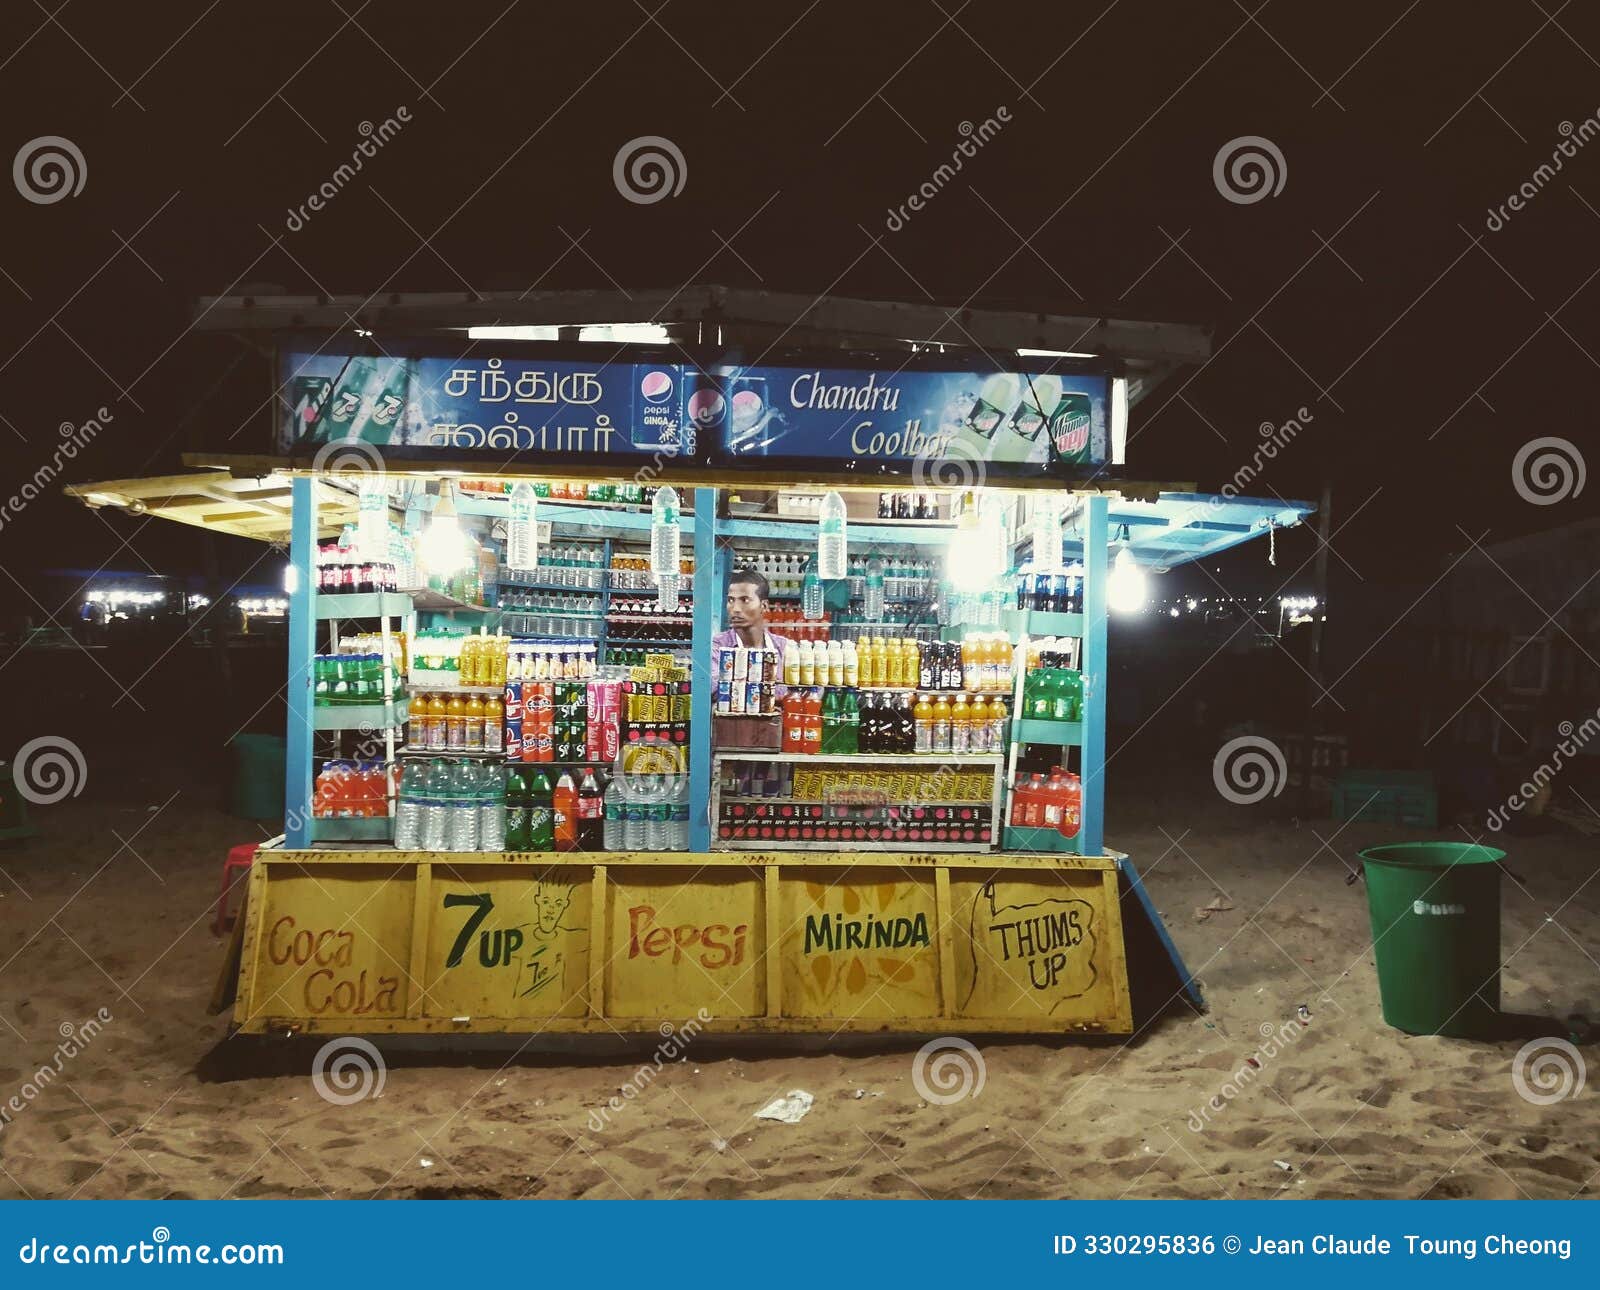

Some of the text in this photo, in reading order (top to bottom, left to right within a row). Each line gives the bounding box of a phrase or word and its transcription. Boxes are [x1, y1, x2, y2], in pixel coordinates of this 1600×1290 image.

[644, 406, 670, 415] pepsi
[791, 372, 900, 412] Chandru
[644, 416, 669, 425] GINGA
[851, 419, 956, 458] Coolbar
[686, 427, 697, 456] epsi
[268, 915, 355, 969] Coca
[628, 904, 748, 970] Pepsi
[989, 910, 1083, 961] THUMS
[1028, 952, 1067, 990] UP
